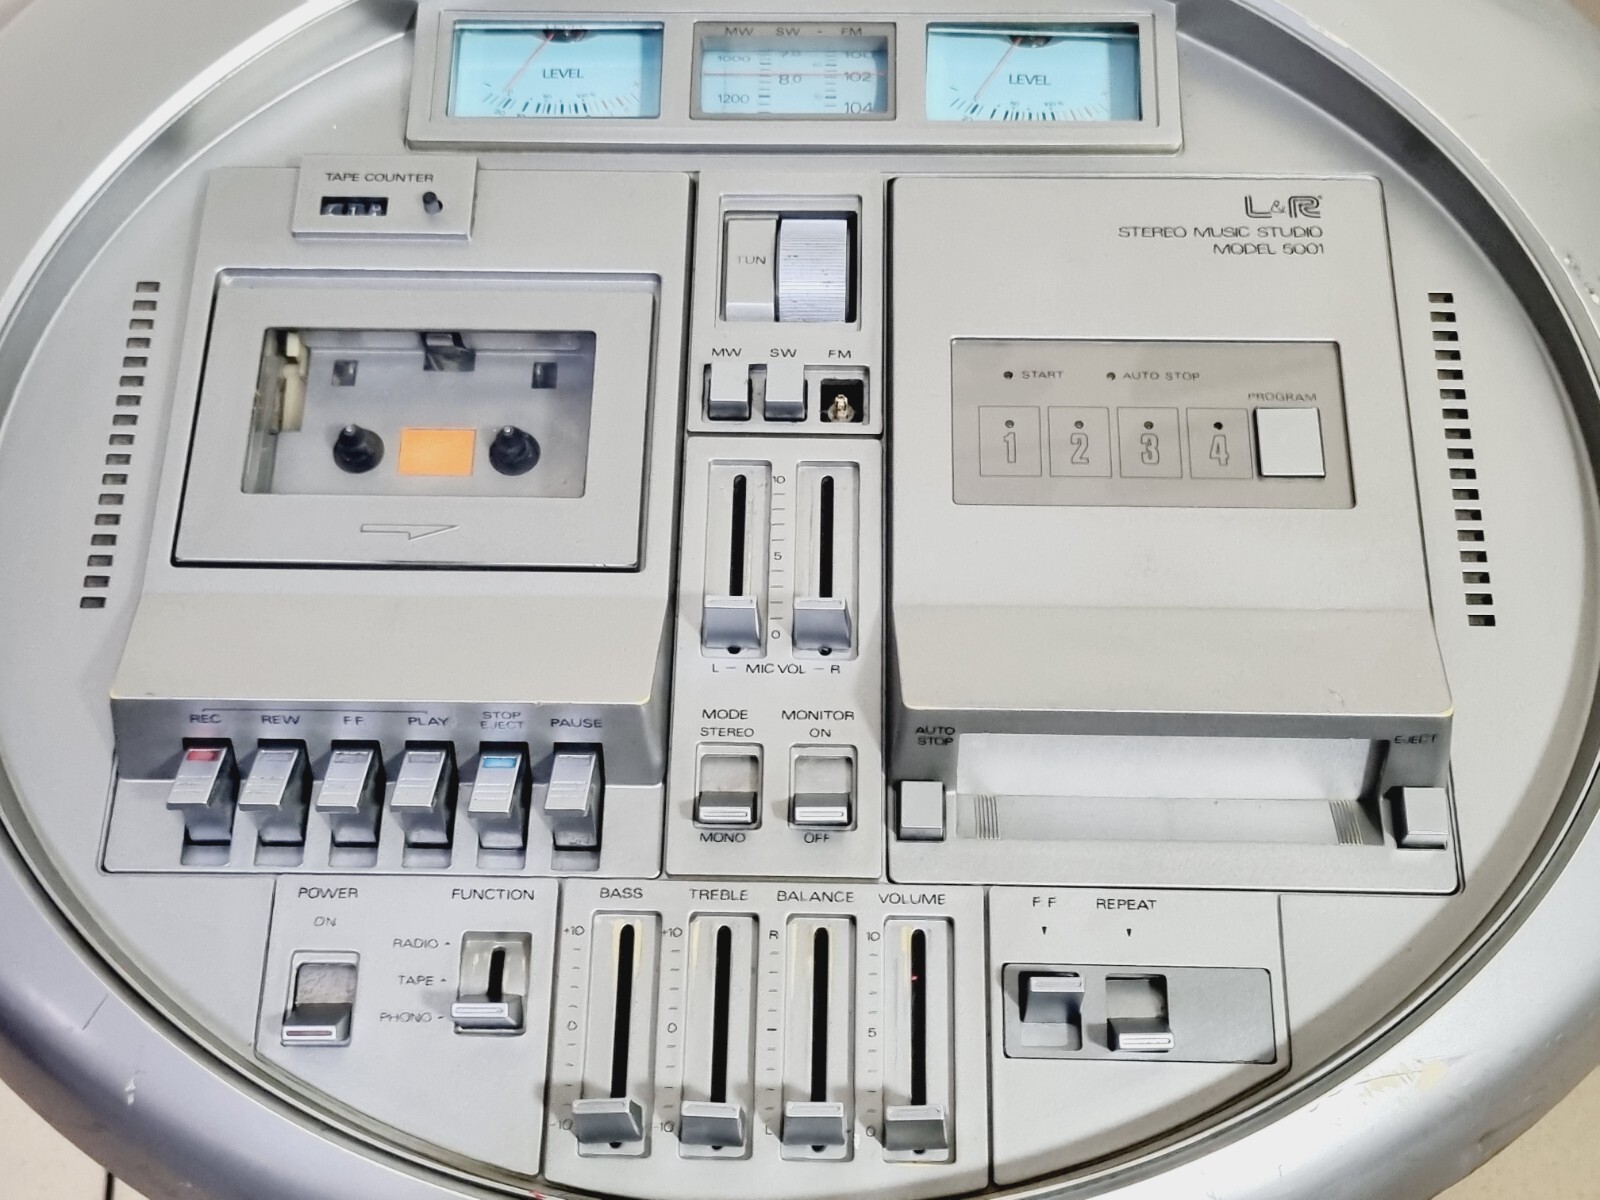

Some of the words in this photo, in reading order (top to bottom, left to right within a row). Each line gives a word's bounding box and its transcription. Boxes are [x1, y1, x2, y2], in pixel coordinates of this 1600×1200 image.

[725, 27, 754, 36] MW
[776, 27, 801, 36] SW
[841, 27, 862, 36] FM
[542, 68, 584, 79] LEVEL
[844, 72, 872, 82] 102
[1008, 74, 1051, 85] LEVEL
[718, 94, 750, 104] 1200
[326, 172, 360, 182] TAPE
[364, 173, 434, 183] COUNTER
[1244, 195, 1323, 219] L&R
[1118, 226, 1188, 239] STEREO
[1193, 226, 1250, 239] MUSIC
[1256, 226, 1323, 239] STUDIO
[1213, 244, 1276, 255] MODEL
[1282, 244, 1325, 255] 5001
[712, 348, 742, 357] MW
[770, 348, 797, 358] SW
[828, 349, 852, 359] FM
[1022, 370, 1063, 380] START
[1122, 371, 1159, 381] AUTO
[1165, 371, 1200, 381] STOP
[1247, 392, 1317, 402] PROGRAM
[1003, 432, 1018, 464] 1
[1070, 432, 1090, 465] 2
[1139, 433, 1160, 466] 3
[1208, 434, 1230, 466] 4
[772, 475, 785, 484] 10
[774, 552, 783, 561] 5
[771, 630, 781, 640] 0
[712, 663, 719, 674] L
[830, 664, 841, 675] R
[190, 713, 222, 724] REC
[260, 713, 301, 725] REW
[482, 710, 521, 720] STOP
[702, 709, 749, 720] MODE
[781, 710, 855, 721] MONITOR
[407, 716, 449, 727] PLAY
[481, 720, 524, 731] EJECT
[550, 717, 603, 729] PAUSE
[700, 727, 755, 737] STEREO
[809, 728, 832, 738] ON
[915, 725, 955, 736] AUTO
[917, 736, 954, 747] STOP
[700, 832, 746, 843] MONO
[803, 833, 831, 844] OFF
[298, 887, 358, 899] POWER
[451, 888, 535, 901] FUNCTION
[599, 887, 644, 899] BASS
[690, 889, 749, 901] TREBLE
[776, 891, 854, 903] BALANCE
[878, 893, 947, 905] VOLUME
[1096, 898, 1157, 910] REPEAT
[313, 916, 337, 927] ON
[768, 930, 779, 940] R
[866, 931, 881, 942] 10
[393, 938, 439, 949] RADIO
[398, 975, 435, 986] TAPE
[379, 1012, 432, 1023] PHONO
[567, 1020, 577, 1031] 0
[667, 1022, 677, 1033] 0
[868, 1028, 877, 1038] 5
[866, 1126, 876, 1137] 0
